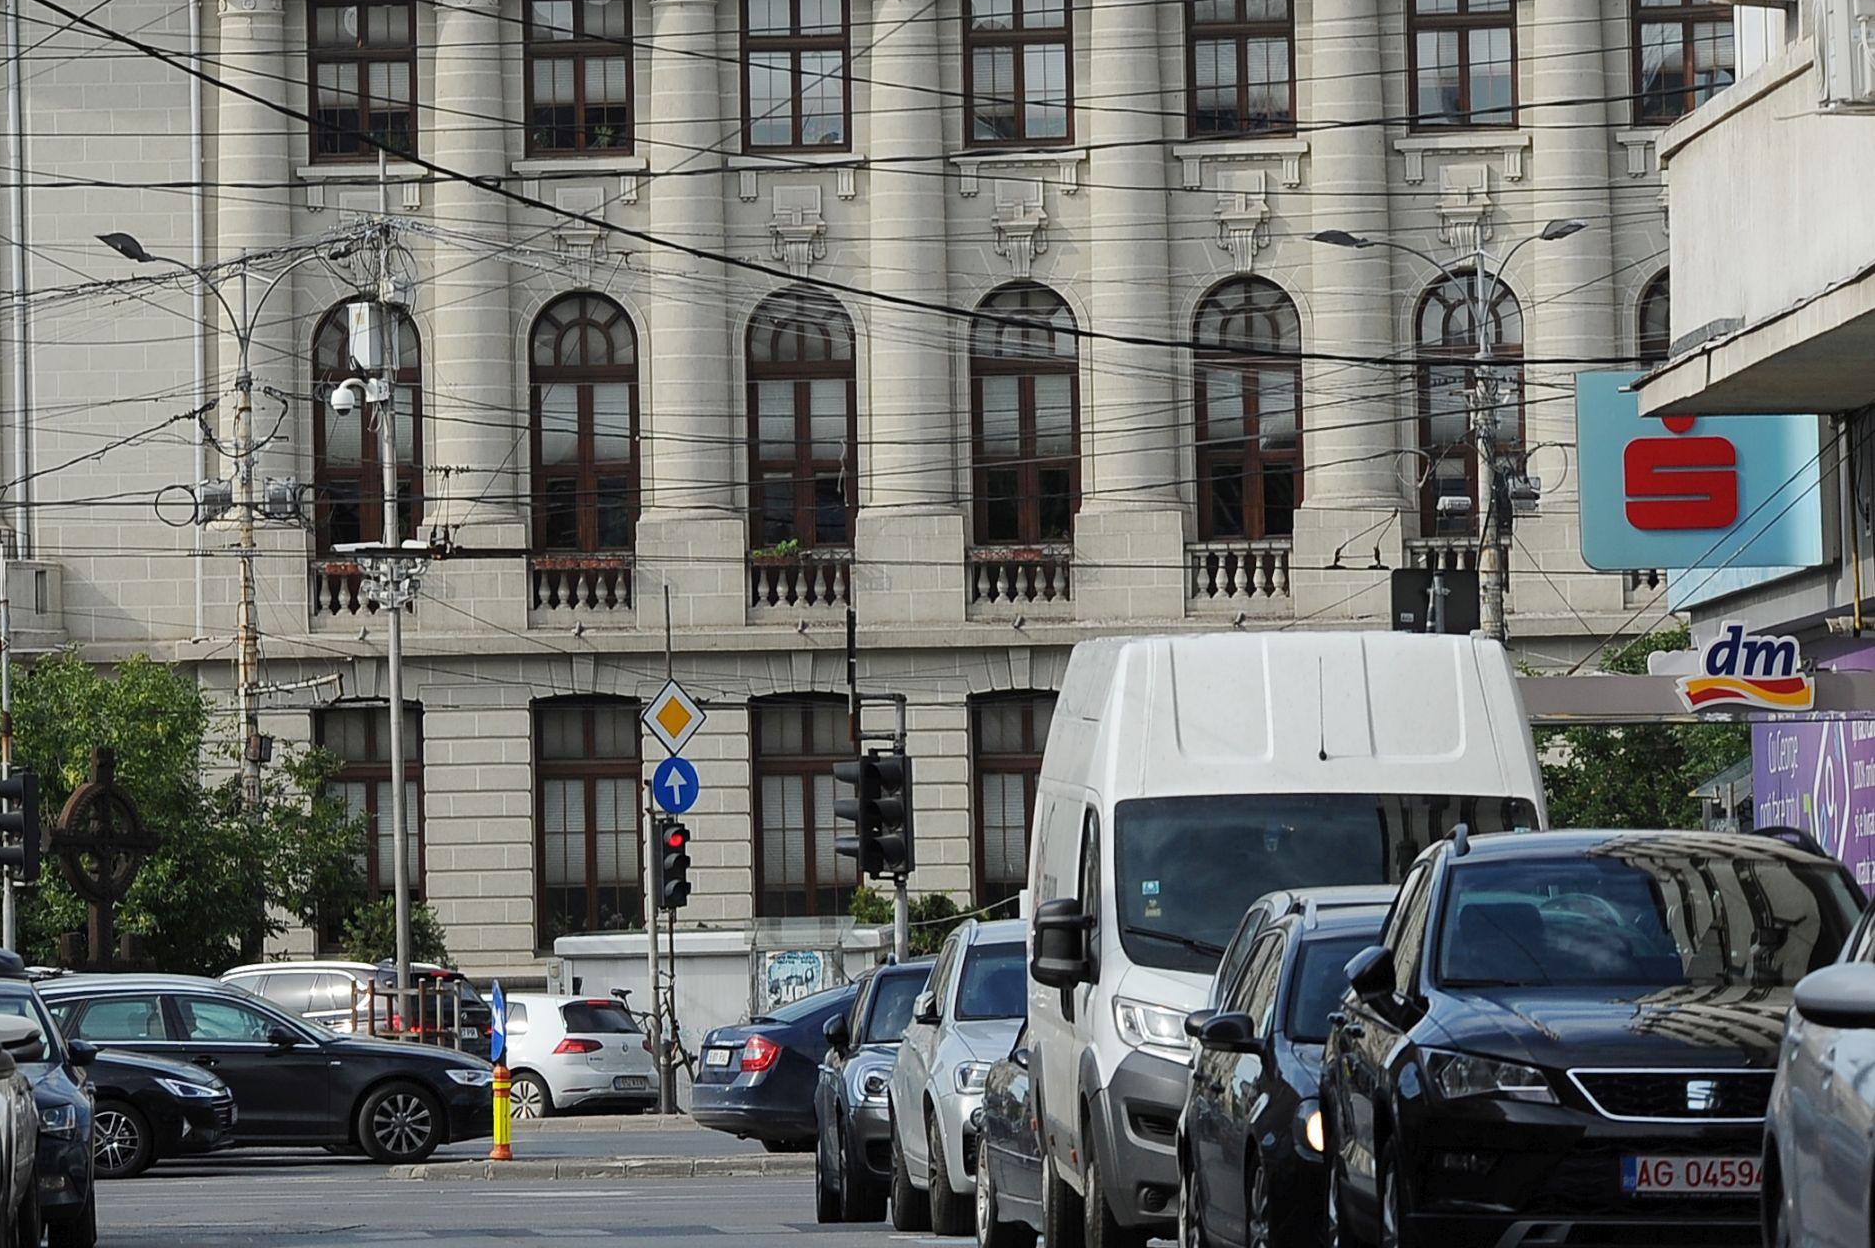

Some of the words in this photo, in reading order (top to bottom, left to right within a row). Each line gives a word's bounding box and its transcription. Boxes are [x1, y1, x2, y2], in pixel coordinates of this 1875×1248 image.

[1706, 625, 1795, 676] dm
[1777, 730, 1799, 779] George
[1637, 1160, 1674, 1187] AG
